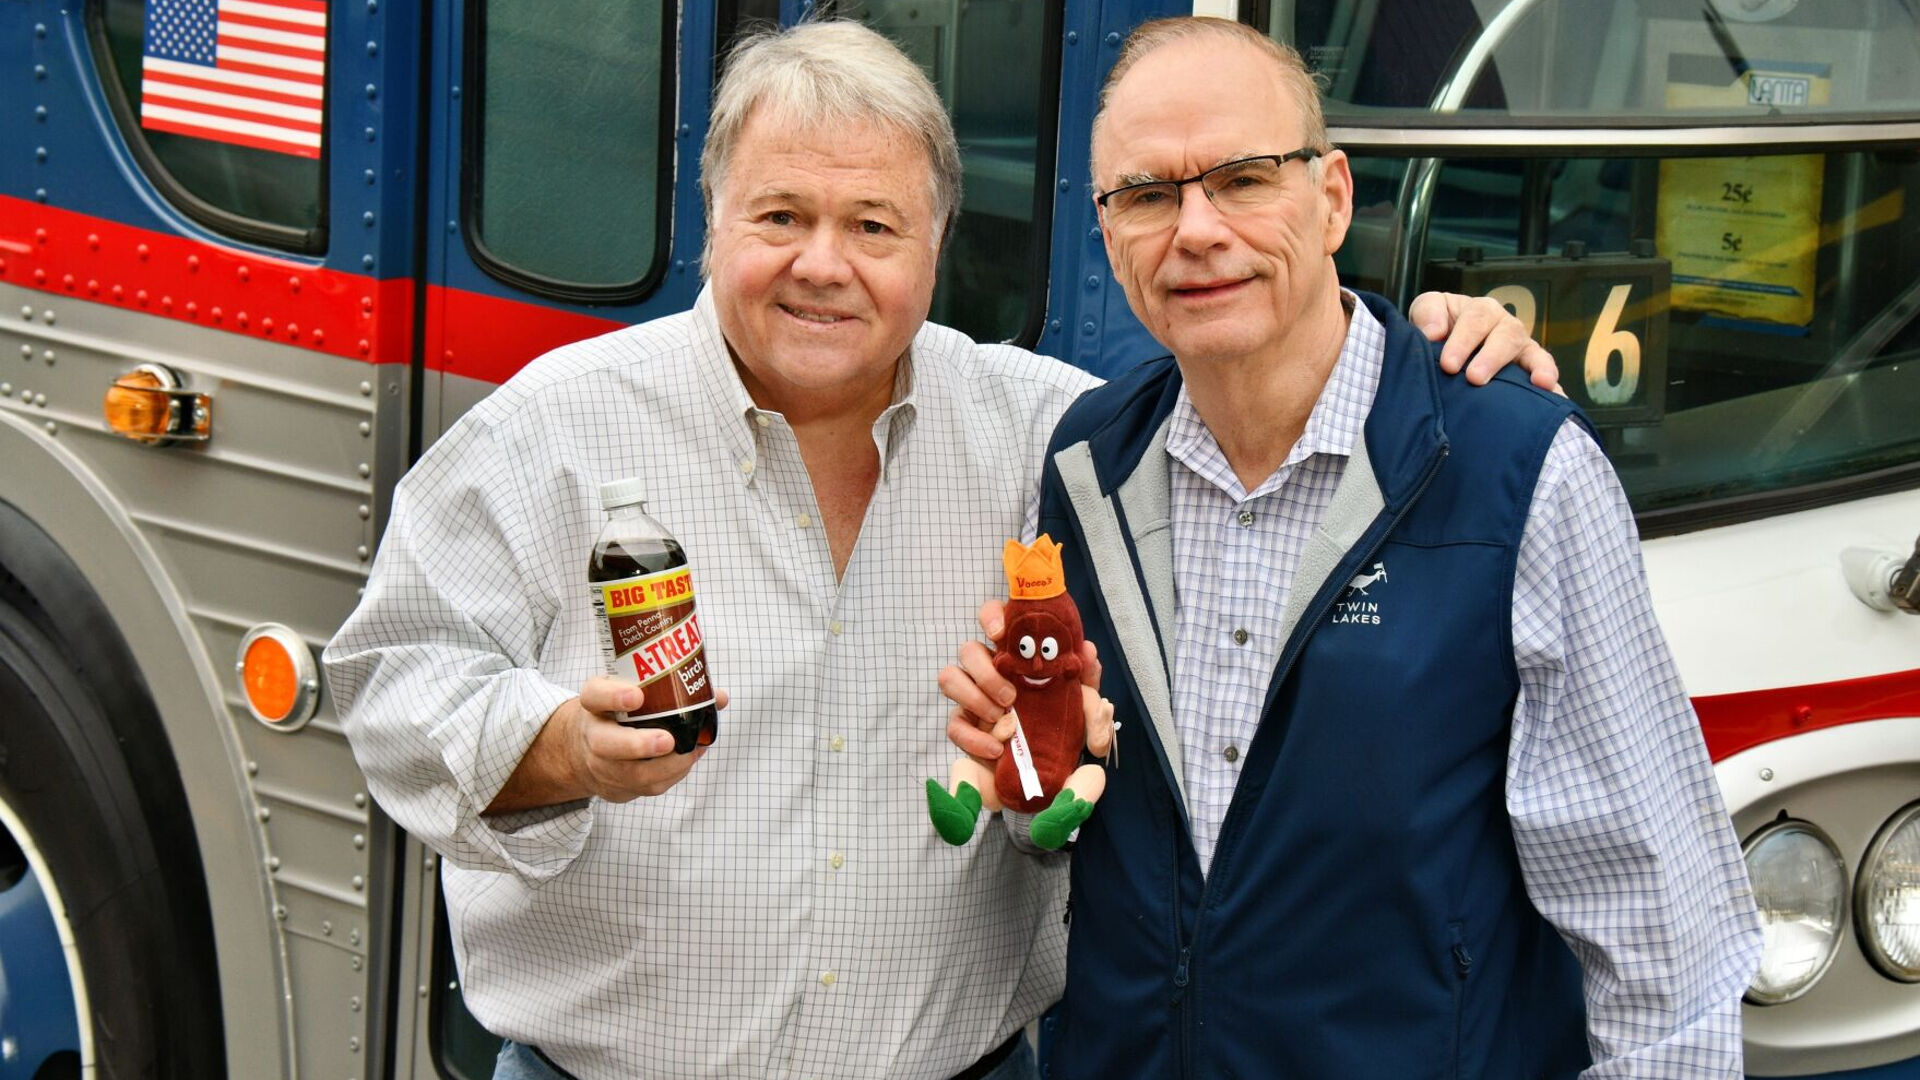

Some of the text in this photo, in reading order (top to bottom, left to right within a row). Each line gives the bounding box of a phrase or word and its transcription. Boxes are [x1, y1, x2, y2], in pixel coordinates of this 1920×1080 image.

[1721, 182, 1753, 205] 25¢
[1721, 232, 1743, 252] 5¢
[609, 586, 646, 609] BIG
[1336, 602, 1379, 613] TWIN
[1332, 613, 1381, 625] LAKES
[618, 625, 639, 638] From
[622, 616, 674, 646] Dutch Country
[631, 613, 702, 682] A-TREAT
[677, 658, 704, 683] birch
[684, 674, 707, 696] beer
